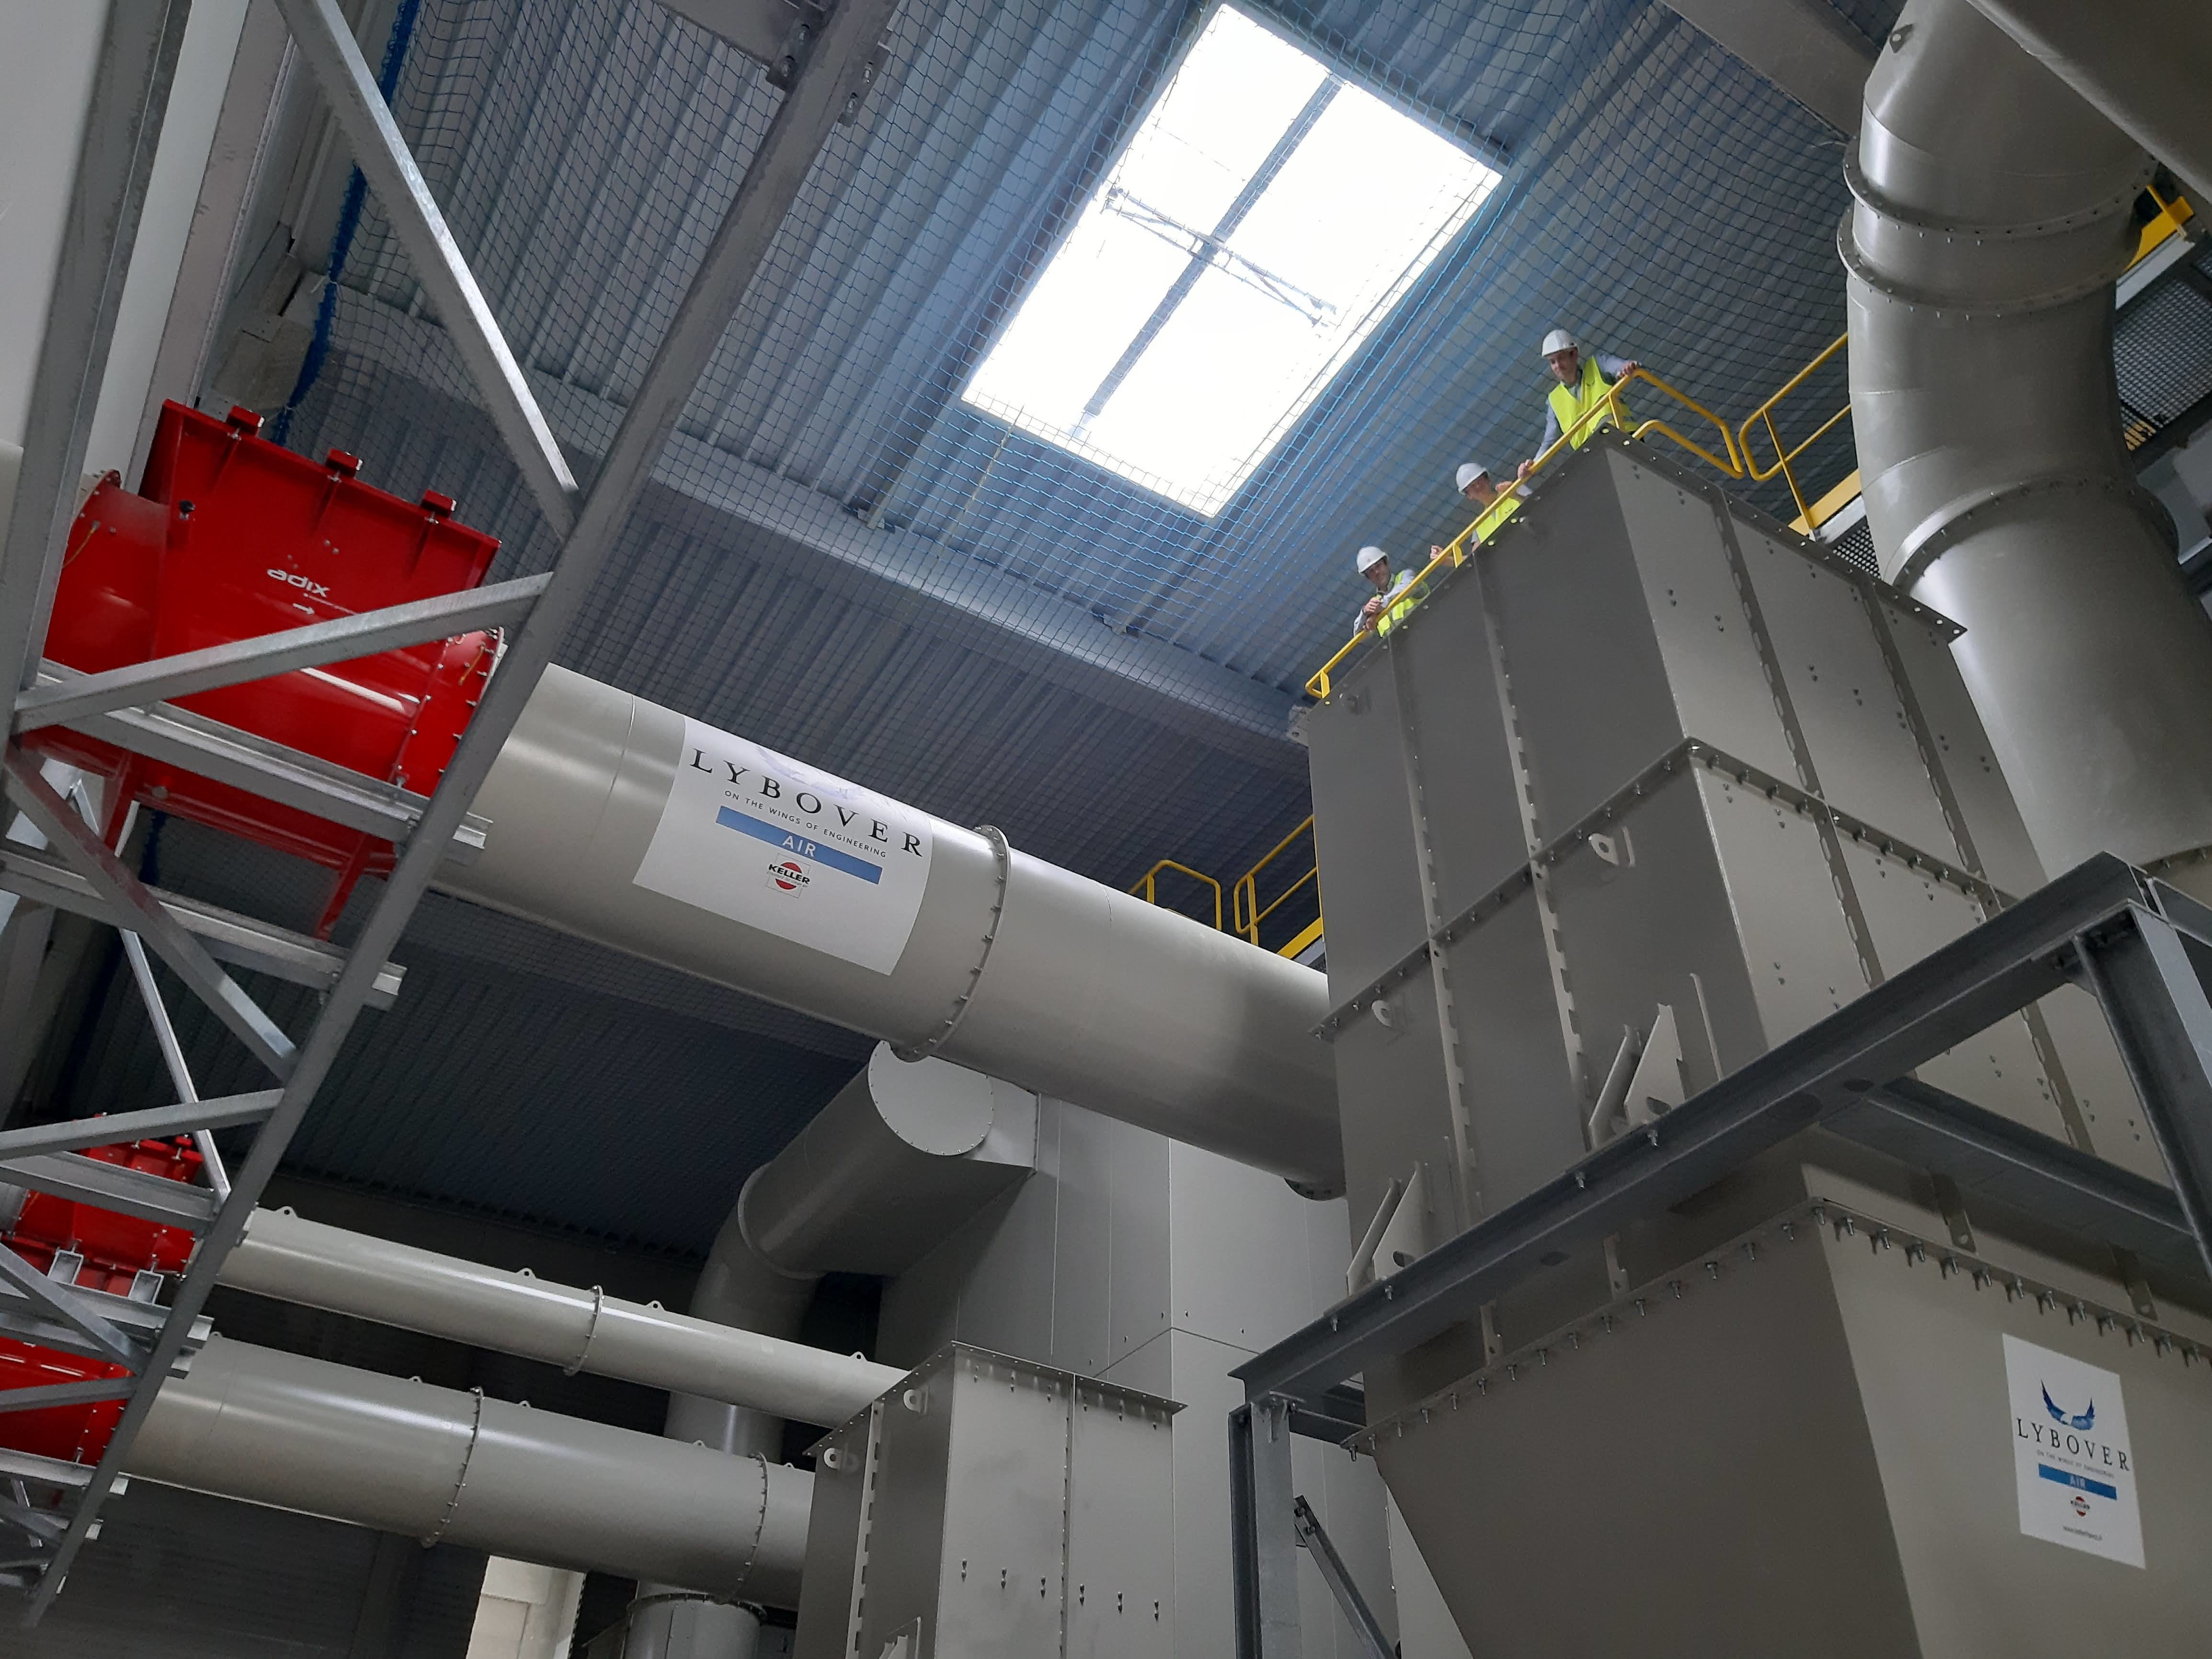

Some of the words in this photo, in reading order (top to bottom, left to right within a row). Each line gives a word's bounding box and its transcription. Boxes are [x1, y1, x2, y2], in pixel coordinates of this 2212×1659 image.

[267, 568, 330, 598] adix
[689, 748, 923, 857] LYBOVER
[725, 790, 740, 800] ON
[746, 798, 764, 809] THE
[769, 807, 801, 824] WINGS
[806, 822, 819, 830] OF
[823, 829, 886, 858] ENGINEERING
[782, 835, 816, 857] AIR
[768, 864, 810, 885] KELLER
[2017, 1418, 2130, 1471] LYBOVER
